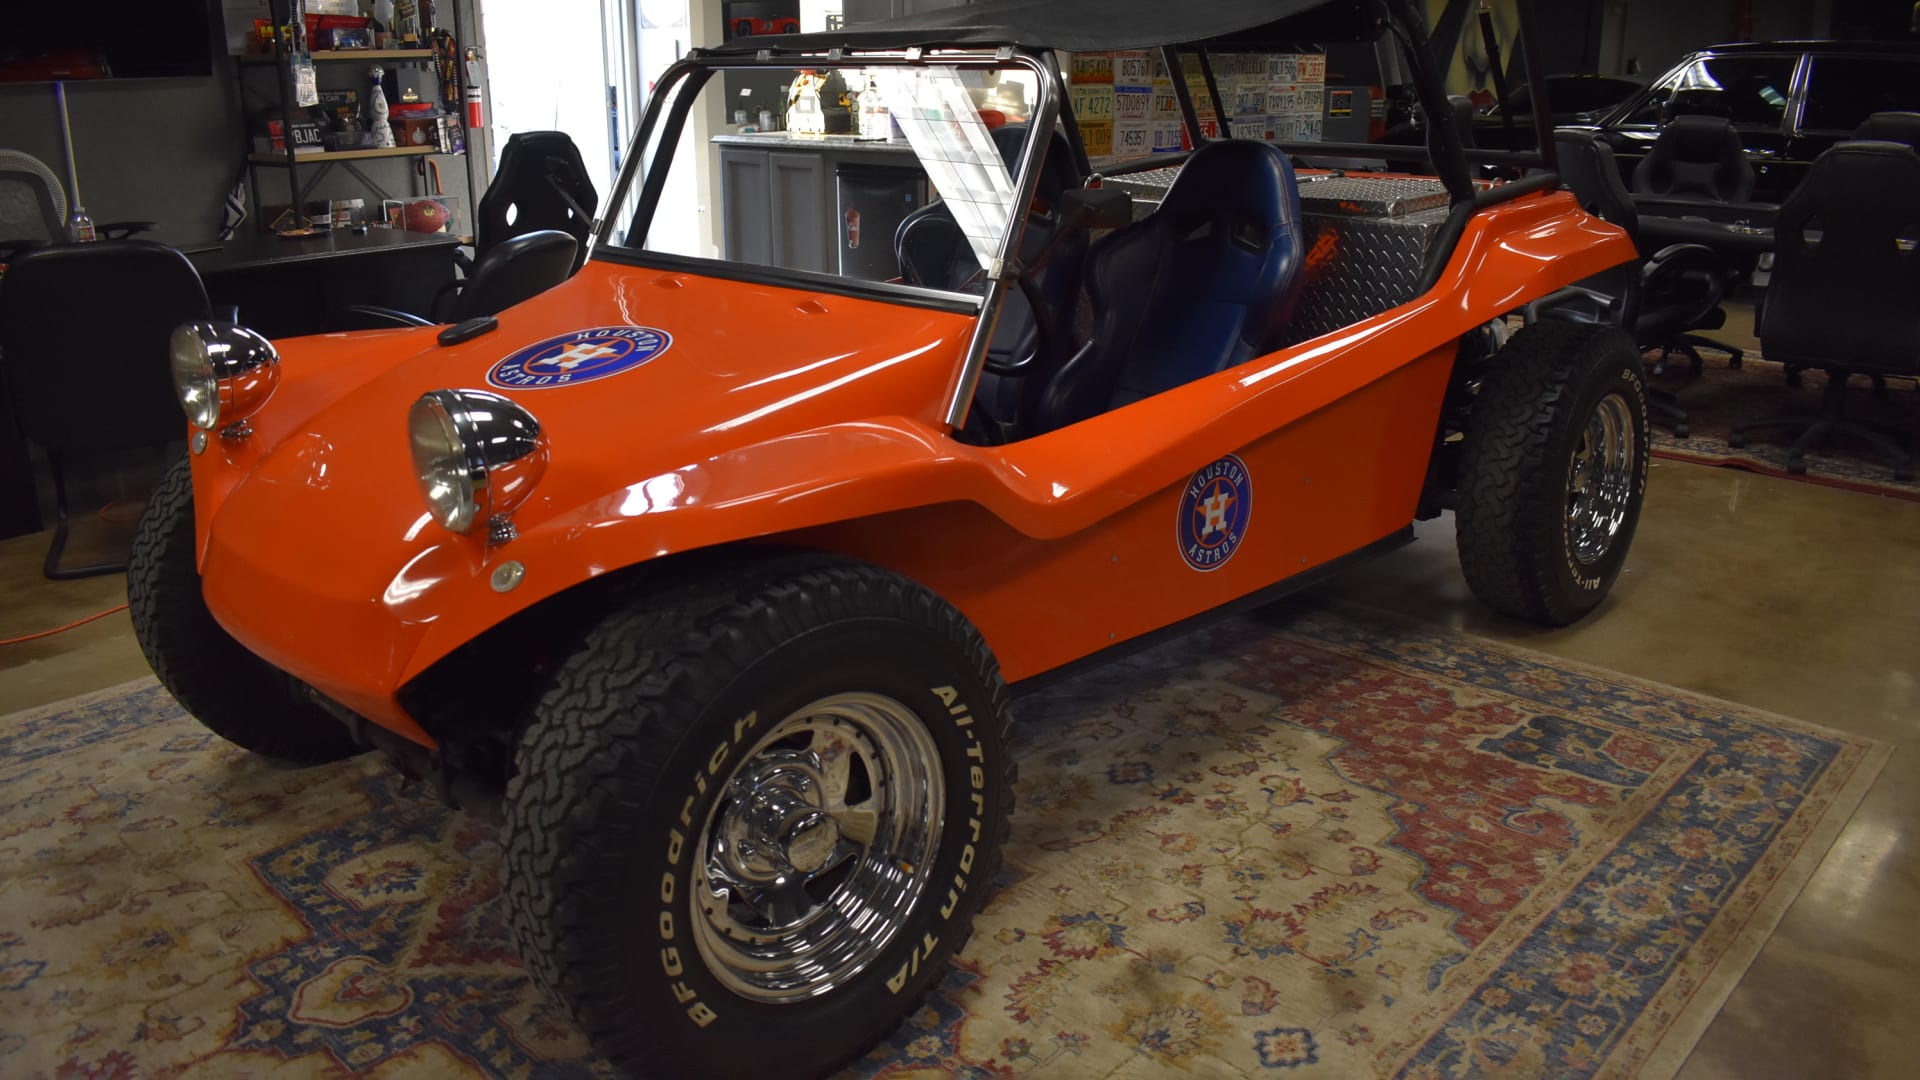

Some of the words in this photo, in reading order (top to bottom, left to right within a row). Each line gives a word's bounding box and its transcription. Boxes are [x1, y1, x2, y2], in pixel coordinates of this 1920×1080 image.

[1088, 96, 1111, 114] 4272
[291, 127, 322, 144] BJAC
[1119, 130, 1147, 146] 745357
[576, 328, 659, 353] HOUSTON
[498, 362, 573, 385] ASTROS
[1620, 368, 1651, 496] BFGoodrich
[1189, 461, 1245, 499] HOUSTON
[1188, 532, 1237, 564] ASTROS
[930, 684, 986, 921] All-Terrain
[659, 709, 759, 1028] BFGoodrich
[885, 931, 940, 995] T/A
